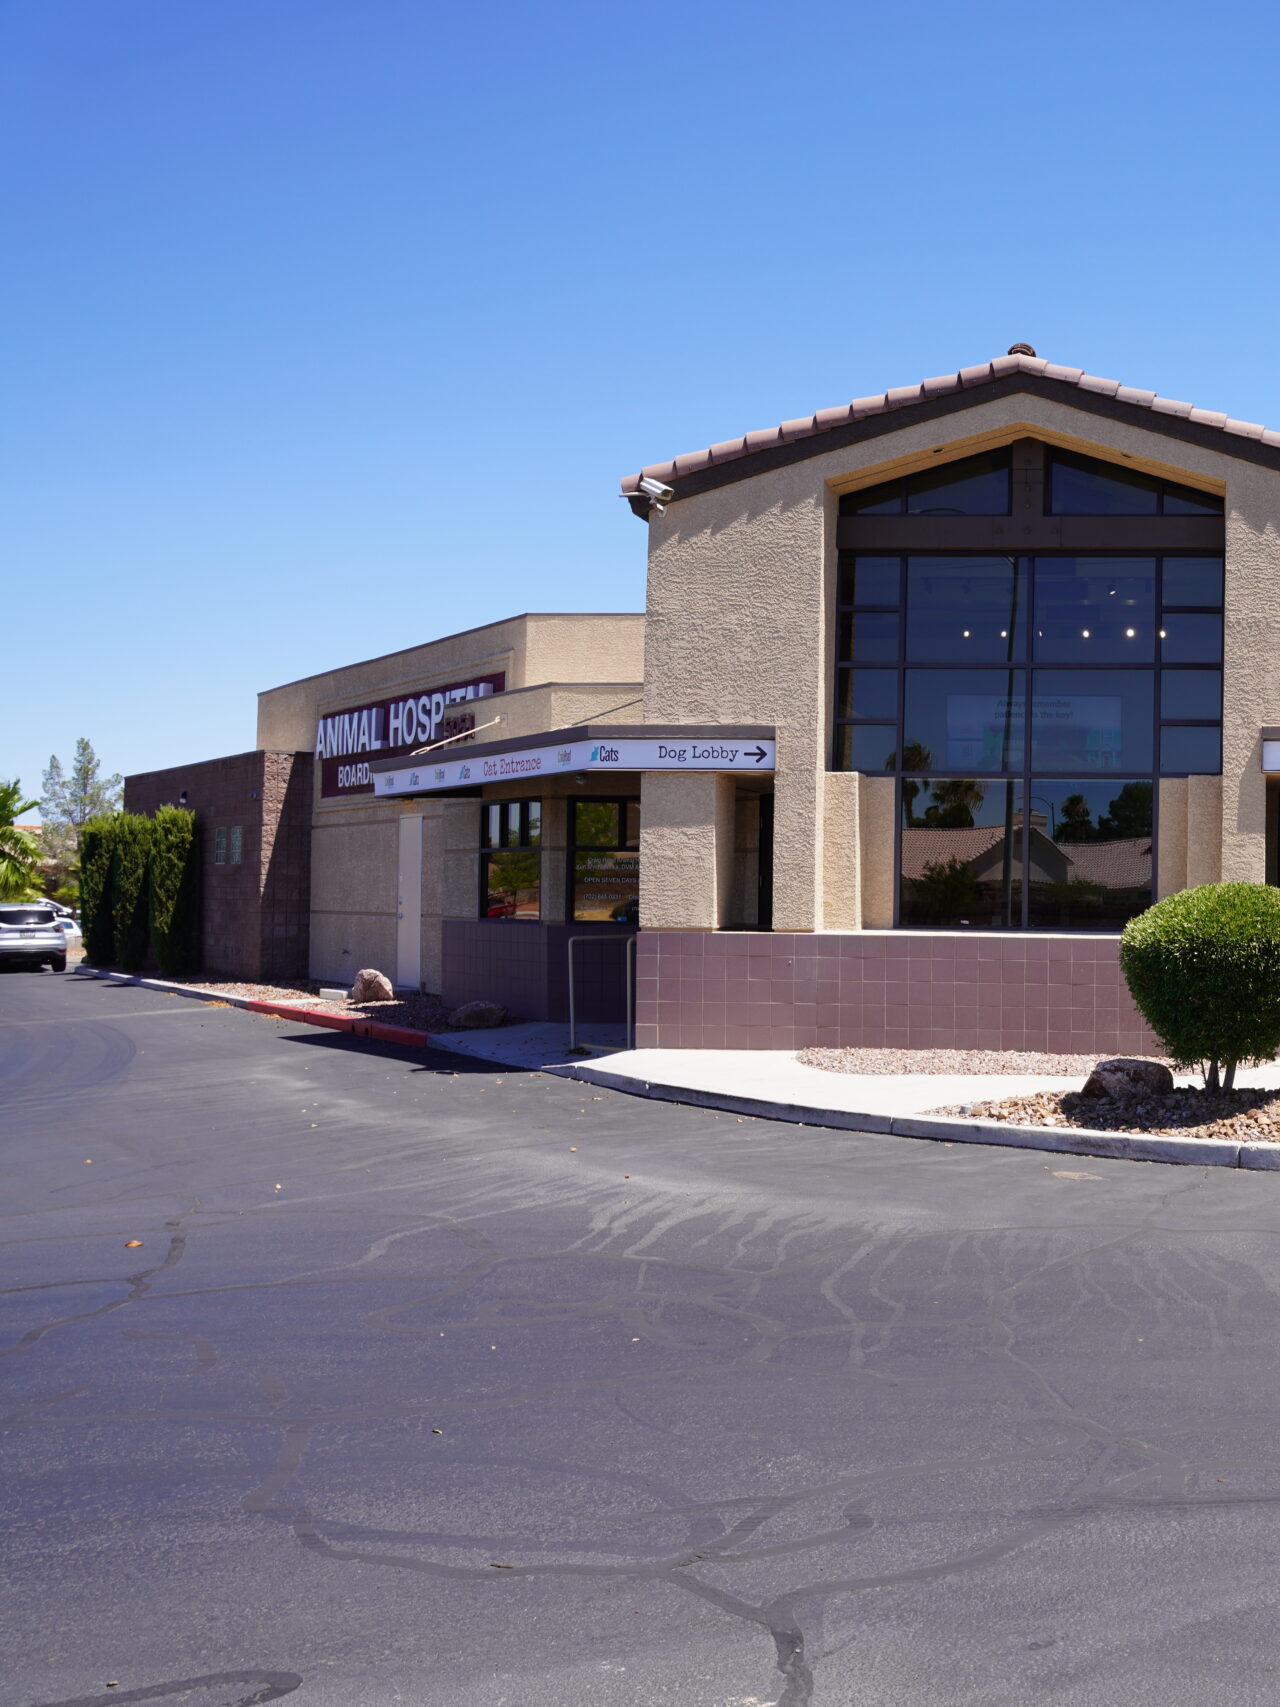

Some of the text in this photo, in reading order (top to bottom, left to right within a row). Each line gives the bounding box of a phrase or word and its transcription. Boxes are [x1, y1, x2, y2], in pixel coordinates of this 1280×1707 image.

[316, 683, 494, 760] ANIMAL HOSP
[600, 745, 619, 762] Cats
[658, 745, 739, 762] Dog Lobby
[338, 762, 374, 788] BOARD
[483, 757, 542, 776] Cat Entrance
